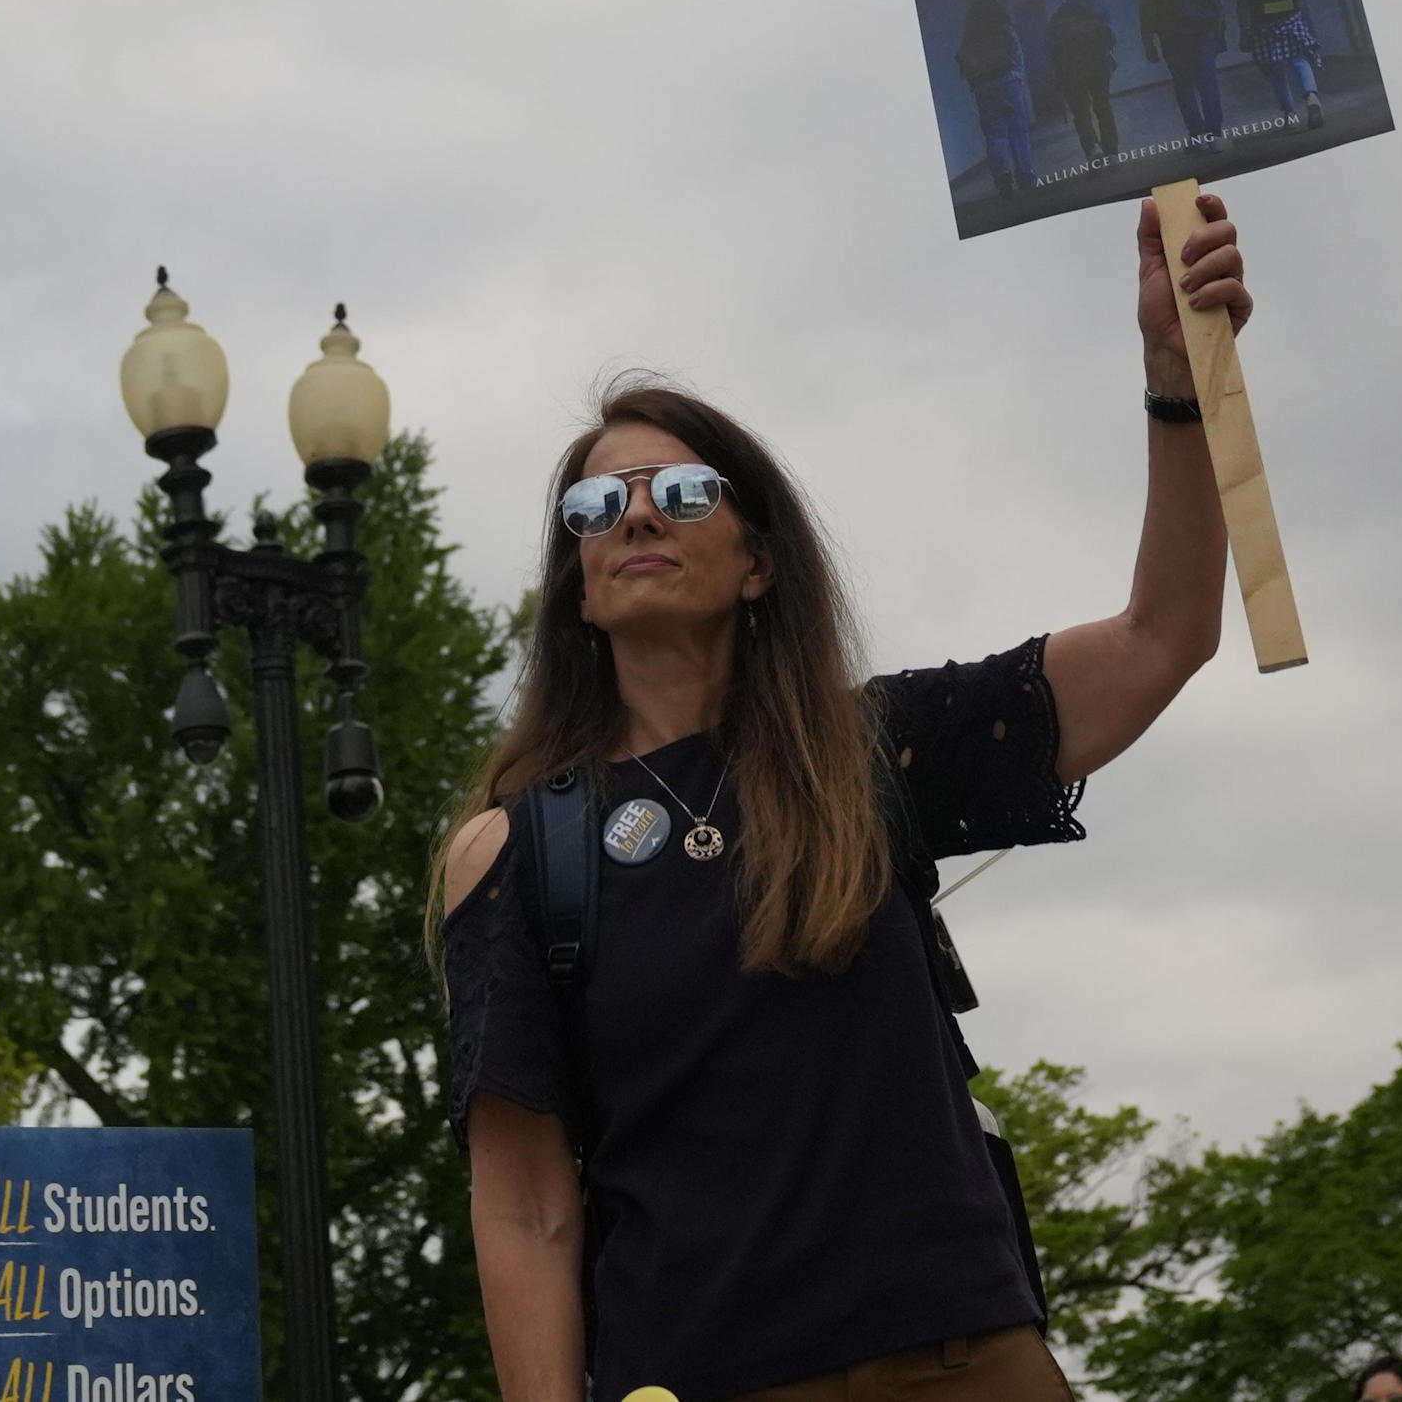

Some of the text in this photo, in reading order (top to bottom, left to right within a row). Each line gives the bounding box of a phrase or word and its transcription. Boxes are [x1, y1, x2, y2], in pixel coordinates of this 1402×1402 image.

[1036, 113, 1301, 188] ALLIANCE DEFENDING FREEDOM
[605, 801, 647, 848] FREE
[44, 1182, 216, 1233] Students.
[59, 1268, 205, 1329] Options.
[0, 1358, 53, 1402] ALL
